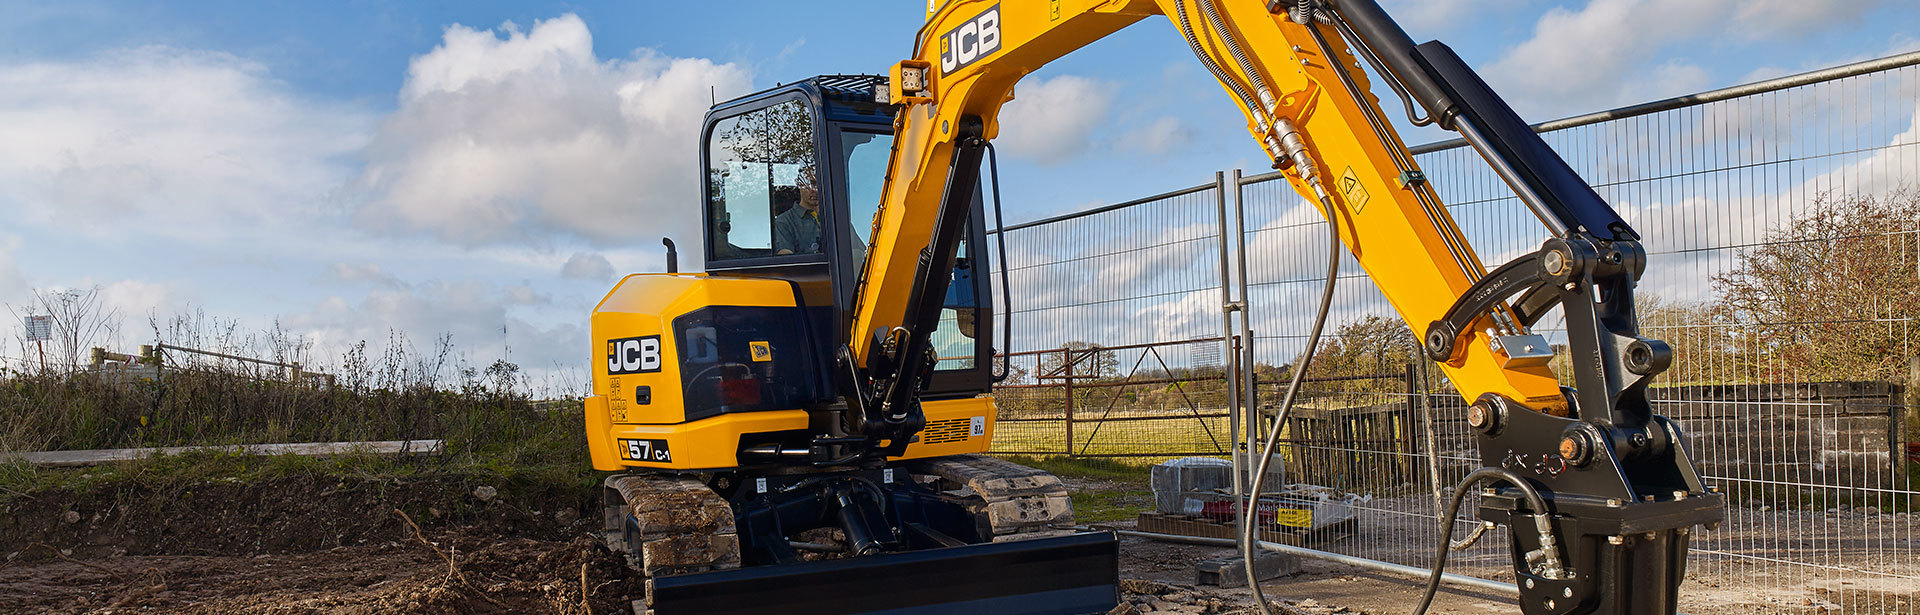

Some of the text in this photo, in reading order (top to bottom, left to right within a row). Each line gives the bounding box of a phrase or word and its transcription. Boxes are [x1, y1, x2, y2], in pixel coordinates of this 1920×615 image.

[942, 9, 1000, 73] JCB
[608, 338, 660, 372] JCB
[628, 440, 650, 459] 57
[655, 449, 671, 461] C-1
